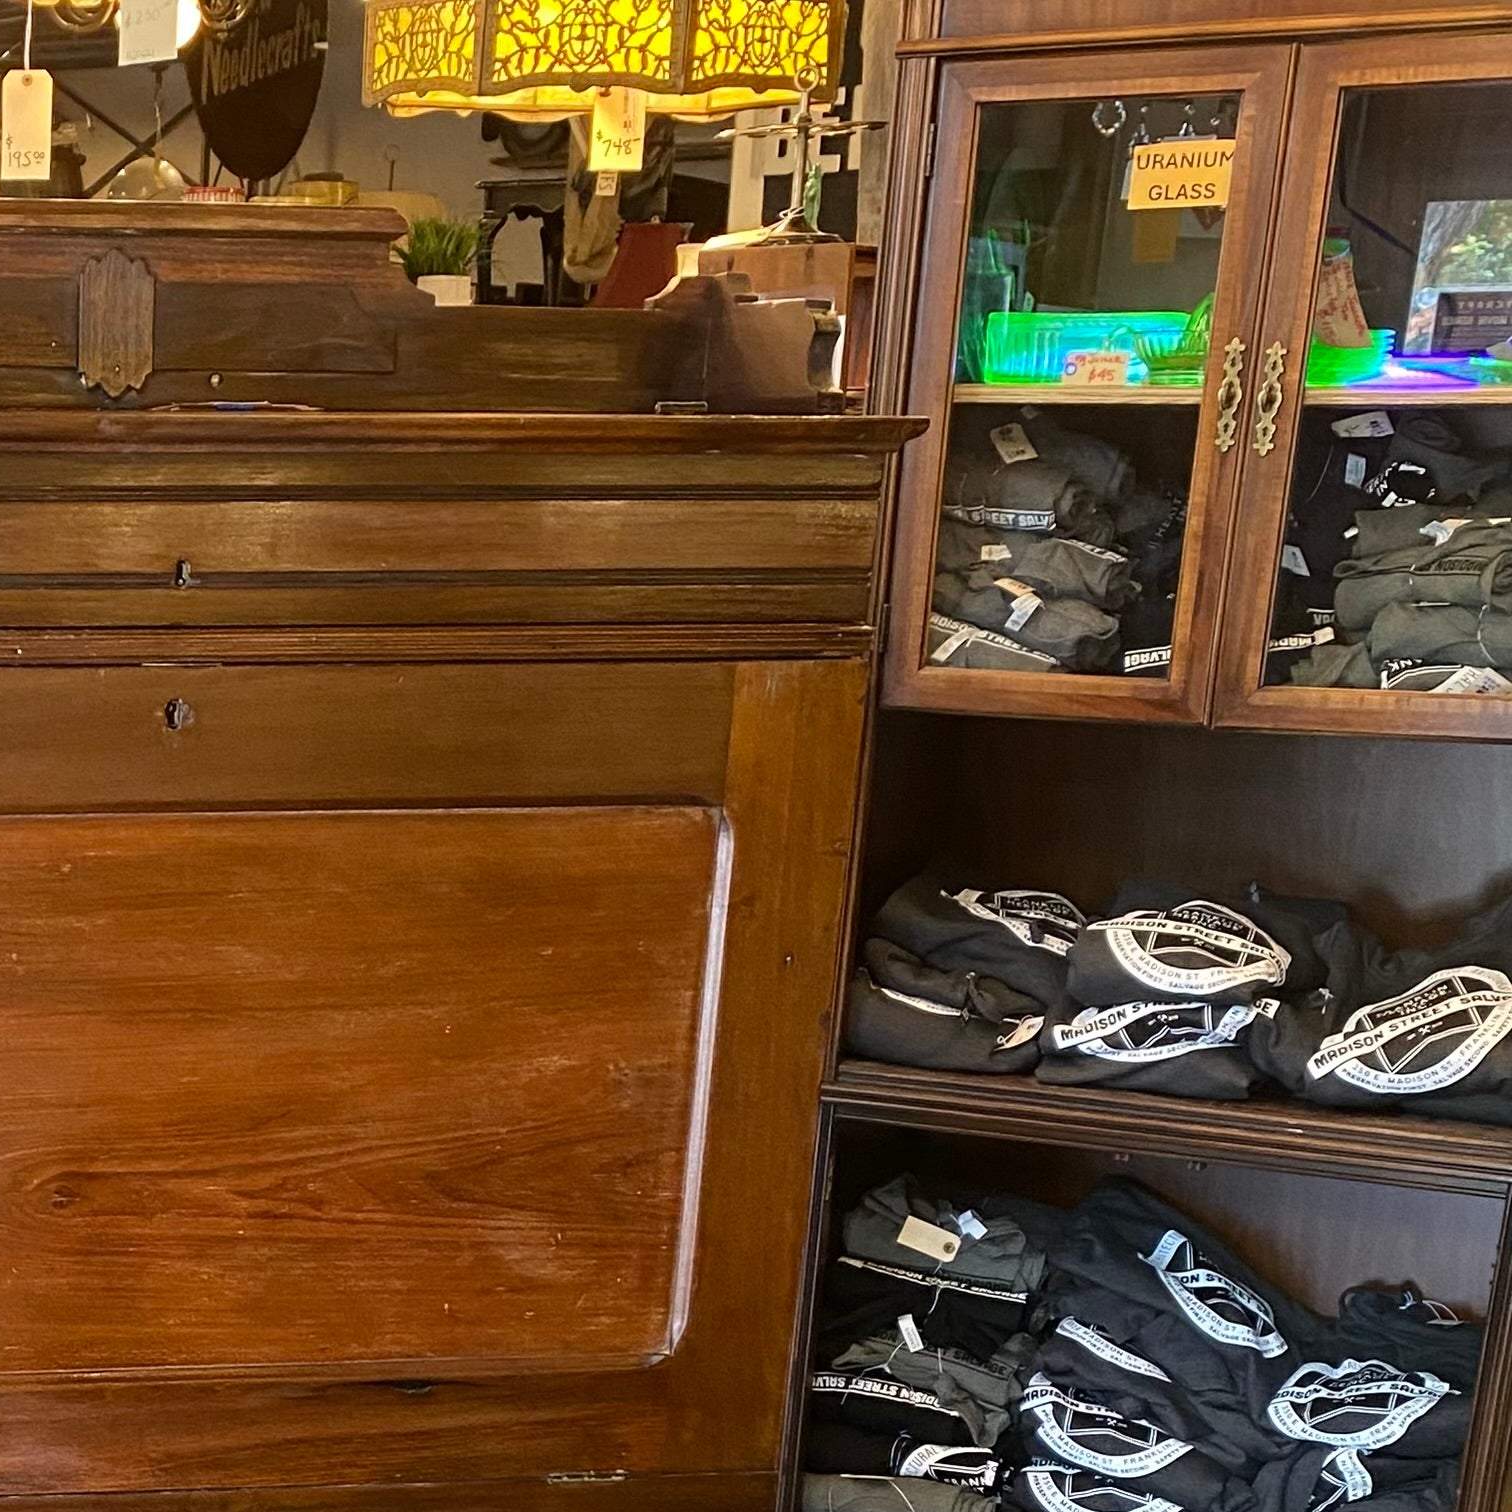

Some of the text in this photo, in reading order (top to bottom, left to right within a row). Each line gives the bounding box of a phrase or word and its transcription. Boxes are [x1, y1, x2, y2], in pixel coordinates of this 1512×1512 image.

[201, 3, 320, 105] Needlecrafts
[1136, 151, 1234, 170] URANIUM
[1148, 182, 1216, 201] GLASS
[1174, 923, 1234, 945] STREET
[1138, 952, 1182, 979] MADISON
[1060, 1010, 1128, 1042] MADISON
[1312, 1029, 1385, 1070] MADISON
[1388, 1003, 1452, 1032] STREET
[1387, 1070, 1439, 1085] MADISON
[1083, 1329, 1124, 1357] MADISON
[1057, 1431, 1099, 1461] MADISON
[1300, 1427, 1347, 1443] MADISON
